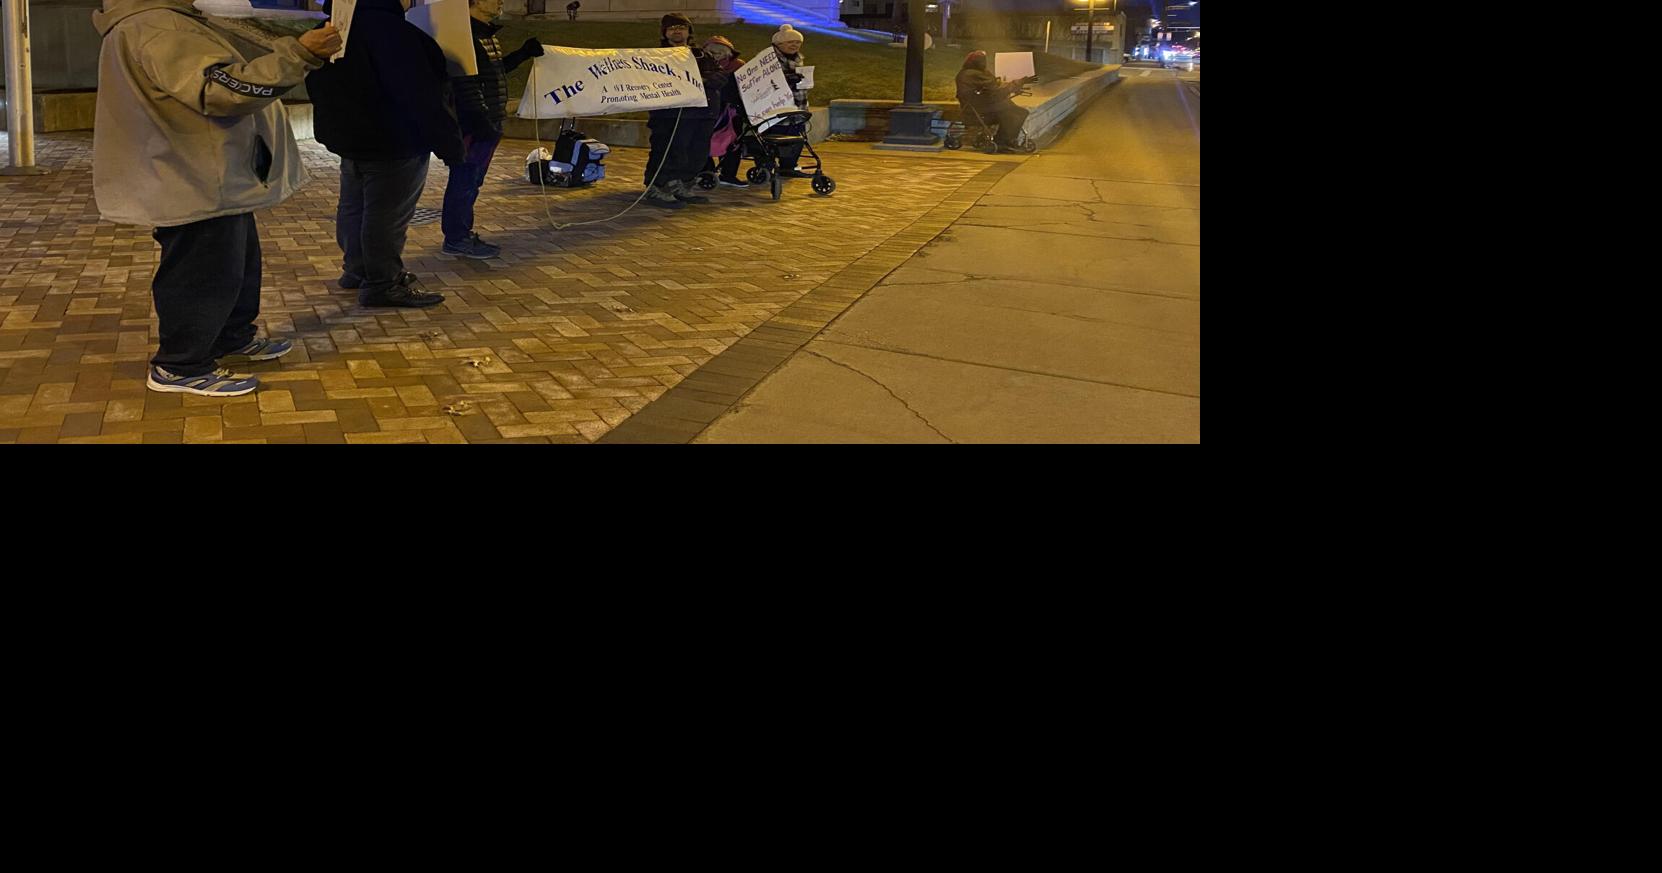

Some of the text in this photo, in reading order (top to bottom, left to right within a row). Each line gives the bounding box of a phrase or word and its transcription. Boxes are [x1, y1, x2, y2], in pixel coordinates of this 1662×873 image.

[763, 61, 782, 78] ALONE
[213, 69, 274, 96] PACERS
[544, 80, 585, 105] The
[632, 56, 682, 80] Shack,
[736, 73, 747, 83] No
[600, 89, 681, 104] Promoting Mental Health
[601, 85, 608, 93] A
